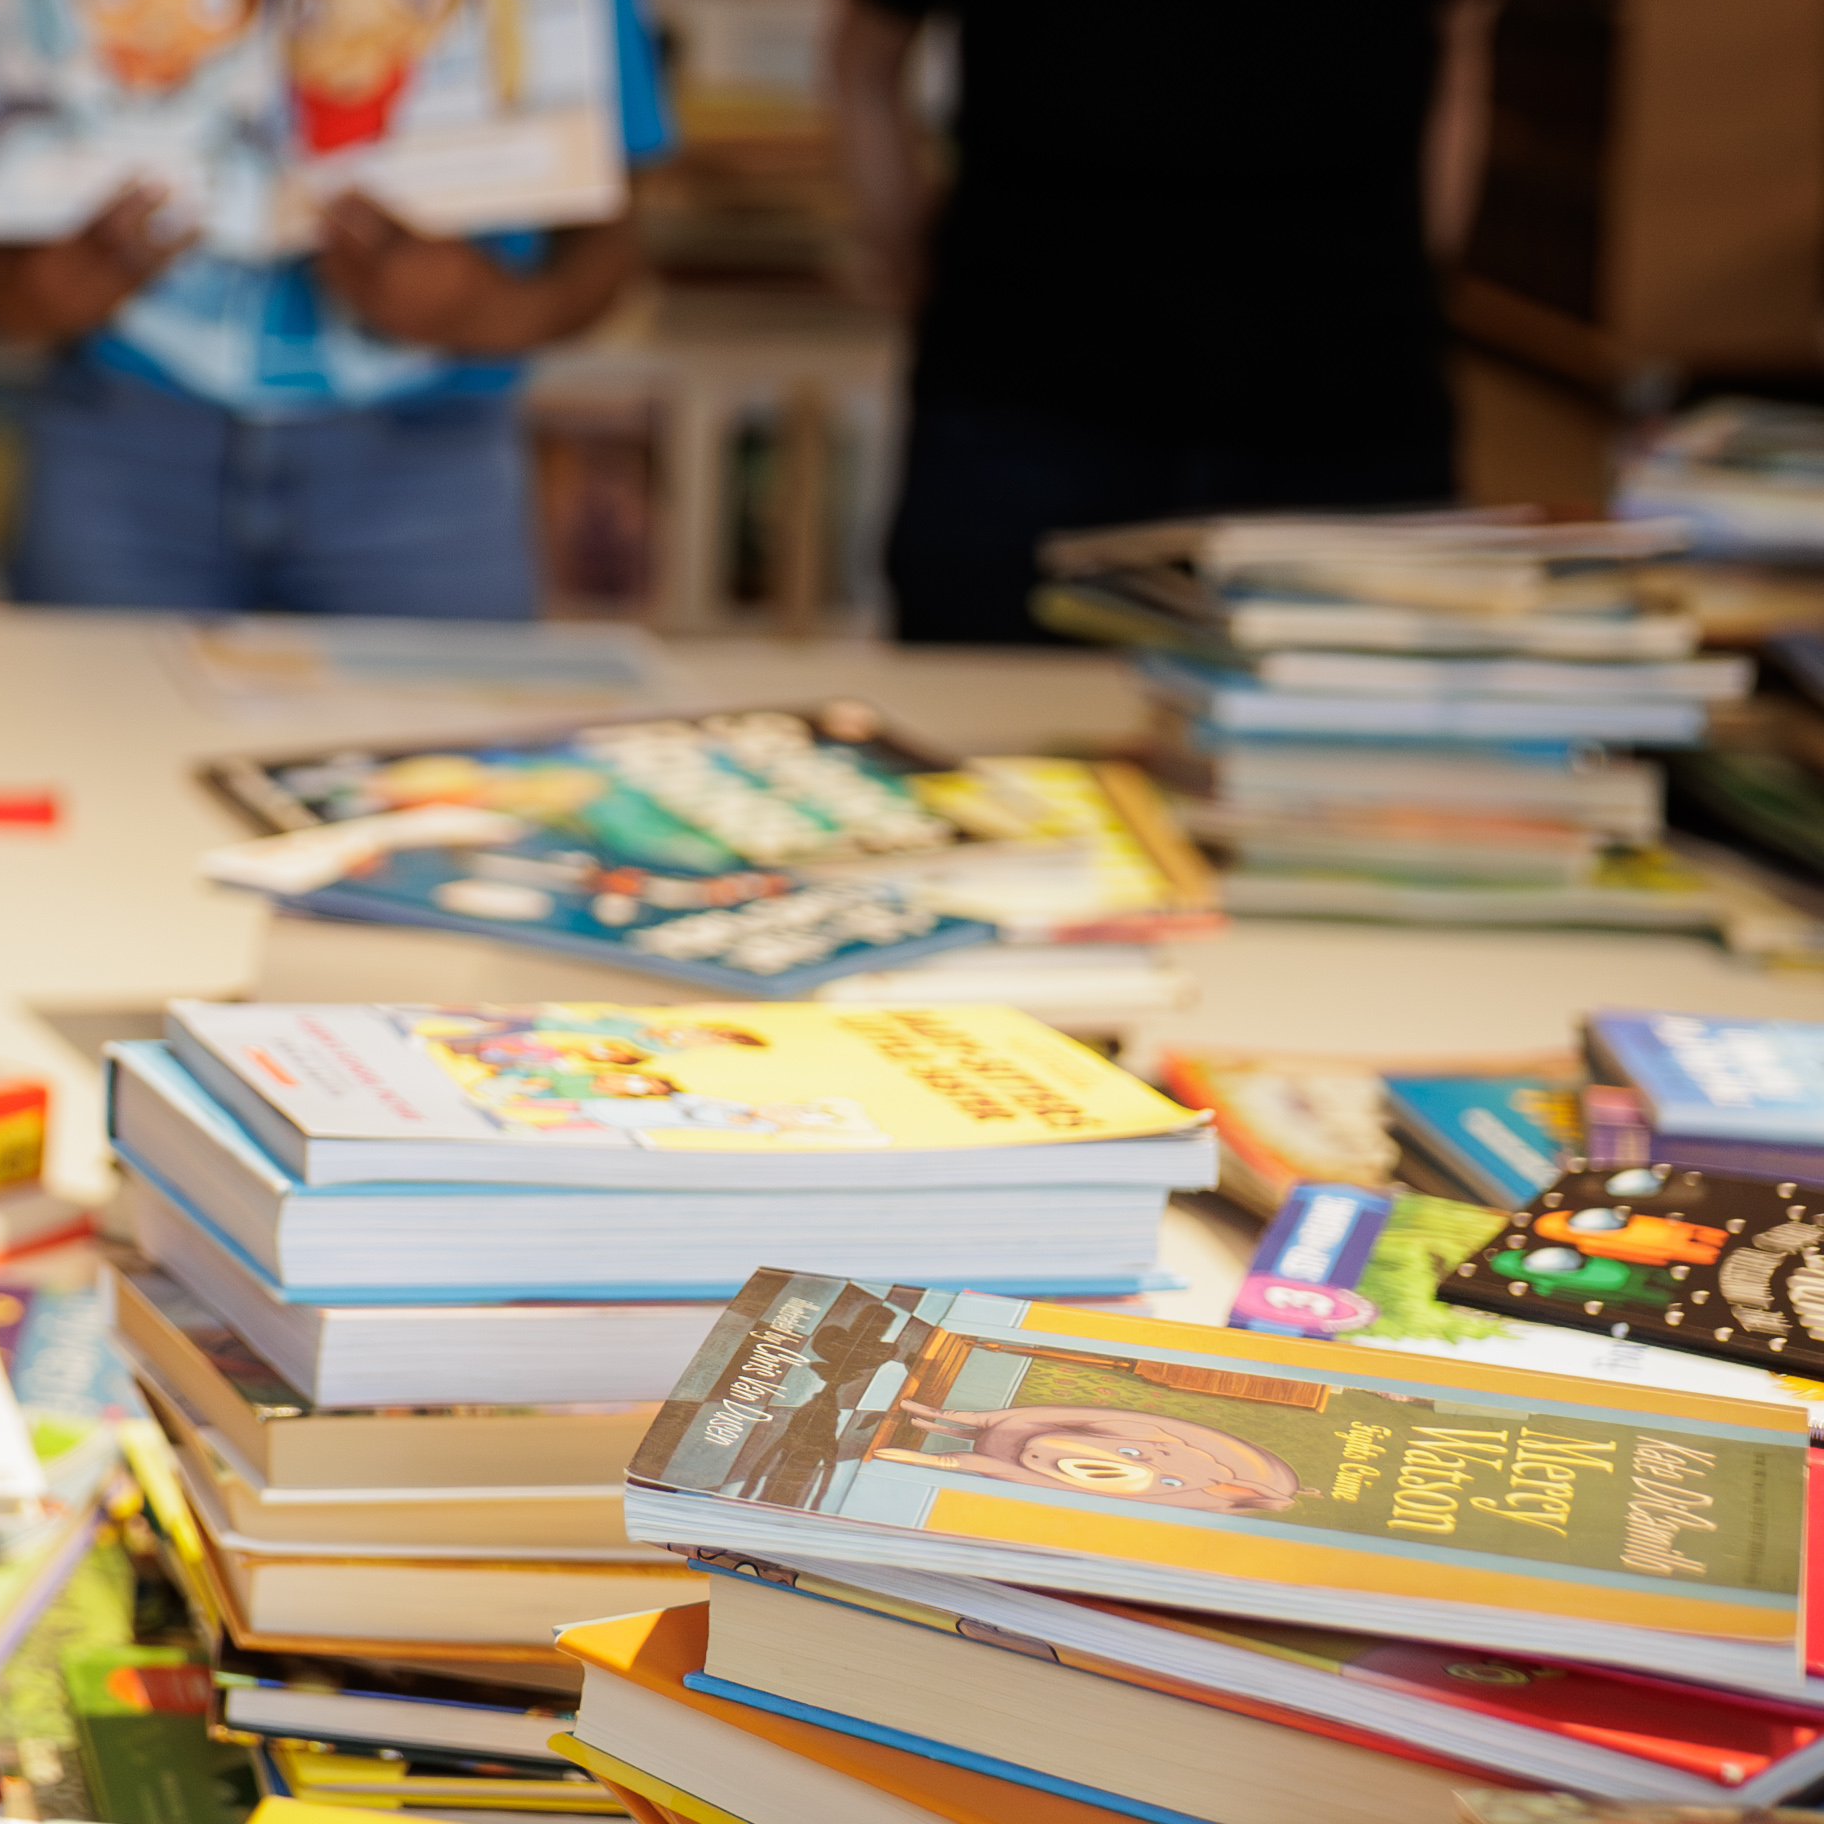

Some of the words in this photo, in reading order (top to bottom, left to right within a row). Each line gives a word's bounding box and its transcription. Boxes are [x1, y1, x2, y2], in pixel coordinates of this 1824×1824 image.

[742, 1343, 810, 1378] Chris
[730, 1375, 788, 1402] Van
[704, 1399, 773, 1447] Dusen
[1336, 1421, 1387, 1461] Fights
[1632, 1434, 1717, 1479] Kate
[1330, 1461, 1382, 1501] Crime
[1386, 1425, 1509, 1534] Watson
[1470, 1427, 1617, 1538] Mercy
[1618, 1475, 1717, 1577] DiCamillo
